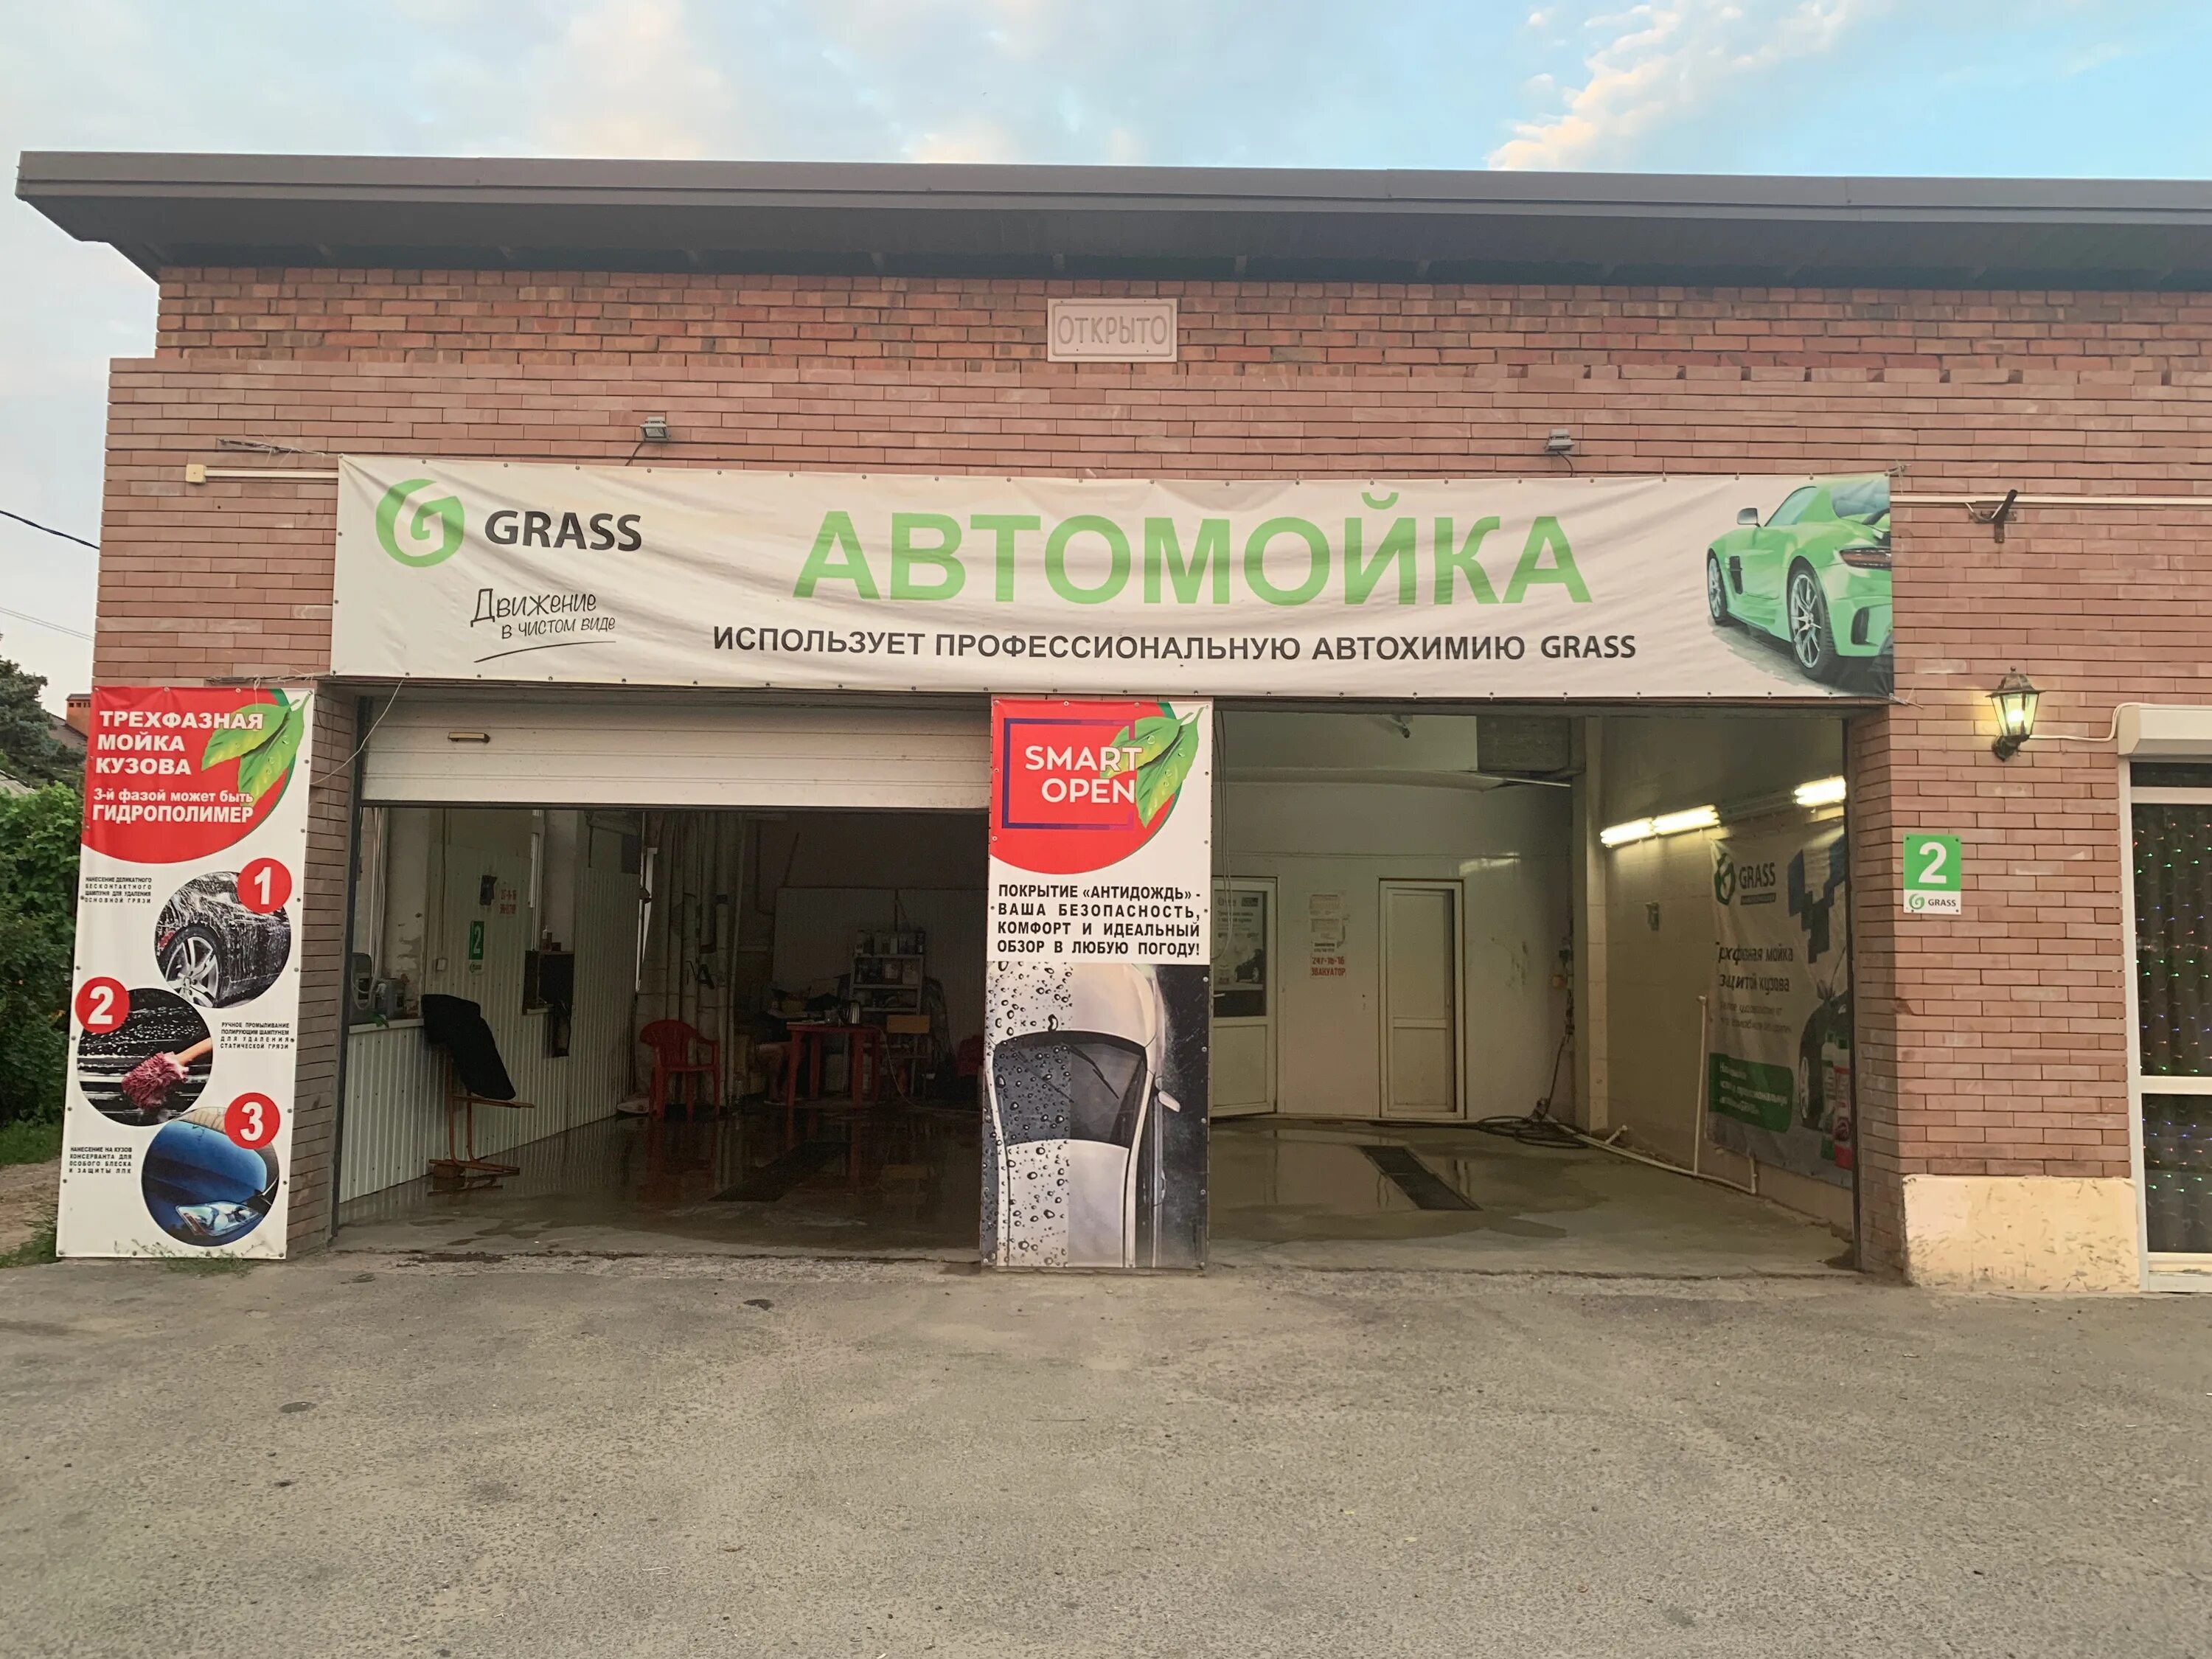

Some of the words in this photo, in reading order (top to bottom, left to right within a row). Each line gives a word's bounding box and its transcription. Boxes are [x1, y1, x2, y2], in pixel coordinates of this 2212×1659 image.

[1057, 315, 1167, 344] ОТКРЫТО
[484, 510, 642, 552] GRASS
[792, 492, 1593, 606] АВТОМОЙКА
[470, 588, 597, 627] Движение
[501, 625, 512, 639] в
[518, 619, 576, 639] чистом
[580, 615, 616, 633] виде
[713, 626, 925, 655] ИСПОЛЬЗУЕТ
[935, 634, 1301, 660] ПРОФЕССИОНАЛЬНУЮ
[1312, 636, 1525, 661] АВТОХИМИЮ
[1540, 636, 1636, 659] GRASS
[100, 711, 263, 730] ТРЕХФАЗНАЯ
[97, 731, 185, 751] МОЙКА
[95, 757, 192, 775] КУЗОВА
[1025, 745, 1144, 772] SMART
[94, 788, 114, 801] 3-й
[119, 789, 166, 803] фазой
[170, 792, 215, 802] может
[219, 790, 254, 803] быть
[1041, 778, 1135, 804] OPEN
[92, 804, 254, 824] ГИДРОПОЛИМЕР
[1739, 862, 1776, 889] GRASS
[1919, 841, 1947, 884] 2
[254, 866, 271, 905] 1
[998, 884, 1078, 898] ПОКРЫТИЕ
[1082, 886, 1192, 901] «АНТИДОЖДЬ»
[998, 902, 1046, 917] ВАША
[1059, 904, 1200, 921] БЕЗОПАСНОСТЬ,
[1928, 899, 1956, 907] GRASS
[473, 925, 481, 954] 2
[998, 922, 1071, 936] КОМФОРТ
[1082, 922, 1092, 935] И
[1104, 922, 1200, 938] ИДЕАЛЬНЫЙ
[998, 940, 1045, 953] ОБЗОР
[1054, 941, 1062, 953] В
[1072, 942, 1129, 955] ЛЮБУЮ
[1138, 942, 1200, 957] ПОГОДУ!
[88, 986, 114, 1025] 2
[240, 1102, 264, 1141] 3
